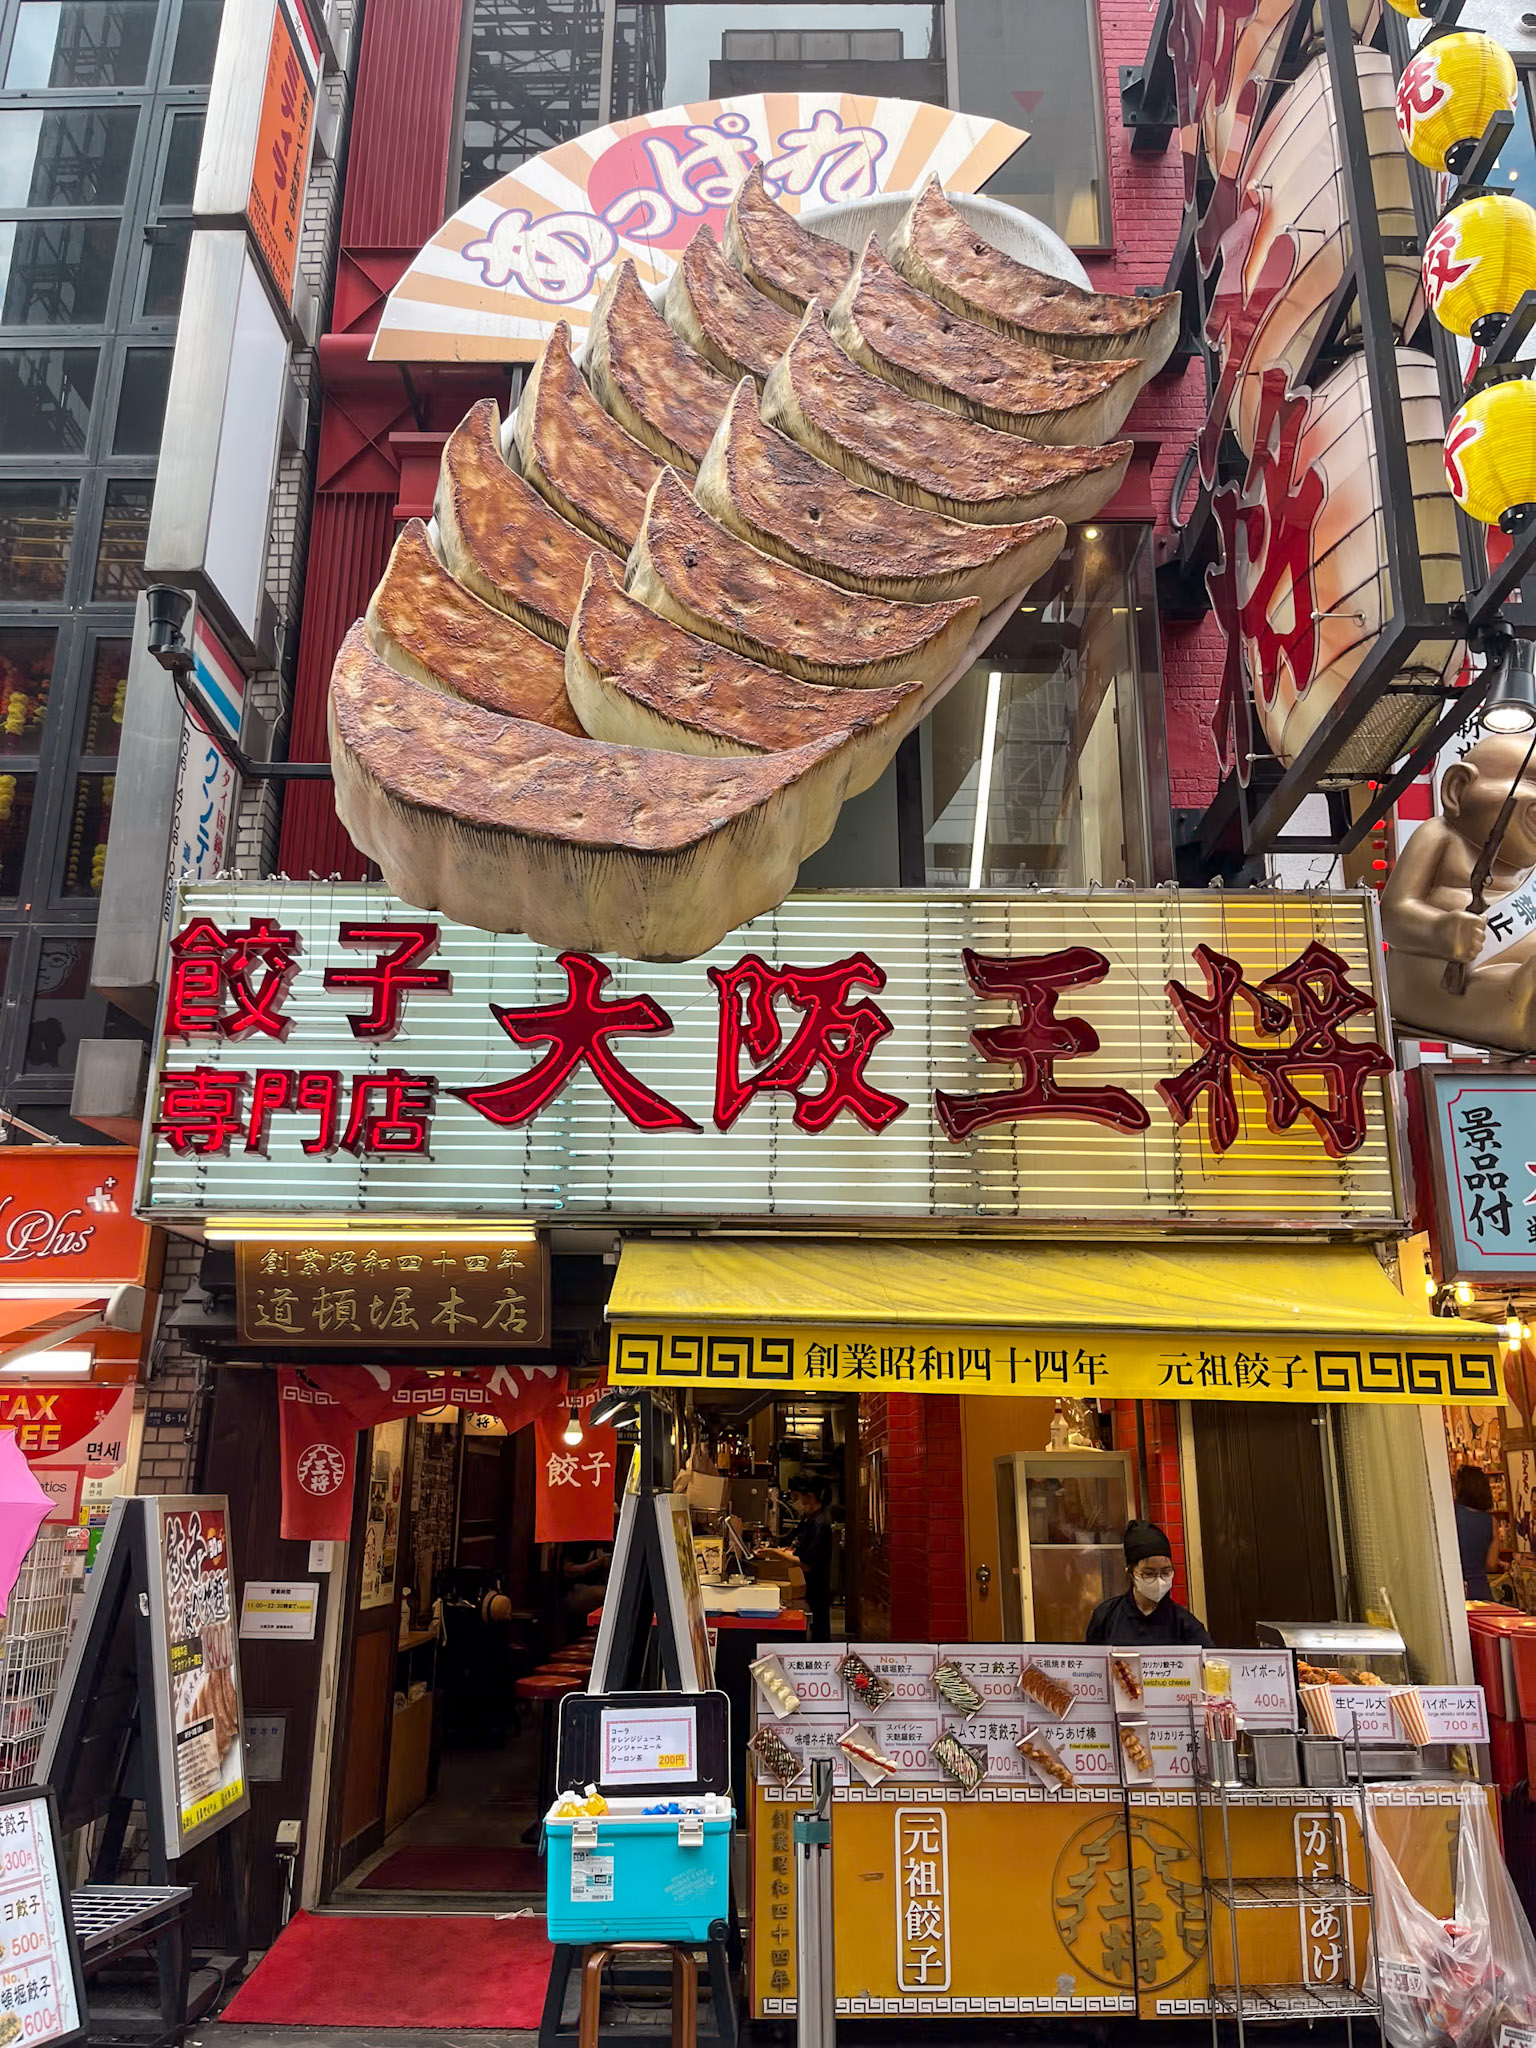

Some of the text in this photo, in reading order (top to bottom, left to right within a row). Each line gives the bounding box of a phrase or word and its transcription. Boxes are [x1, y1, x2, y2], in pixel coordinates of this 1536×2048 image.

[165, 917, 454, 1043] 餃子
[446, 940, 1395, 1158] 大阪王将
[152, 1066, 439, 1157] 専門店
[1458, 1107, 1513, 1237] 景品付
[3, 1208, 95, 1261] Plus
[259, 1248, 526, 1280] 創業昭和四十四年
[254, 1286, 532, 1335] 道頓堀本店
[803, 1342, 1309, 1389] 創業昭和四十四年 元祖餃子
[475, 1413, 490, 1429] 将
[86, 1441, 121, 1461] 면세
[310, 1458, 331, 1493] 王将
[545, 1451, 612, 1488] 餃子
[1035, 1659, 1083, 1669] 元祖焼き餃子
[1241, 1664, 1286, 1678] ハイボール
[1335, 1697, 1386, 1709] 生ビール大
[1422, 1698, 1477, 1710] ハイボール大
[610, 1735, 662, 1744] オレンジジュース
[1443, 1720, 1468, 1730] 700
[610, 1744, 662, 1752] ジンジャーエール
[610, 1754, 643, 1763] ウーロン茶
[659, 1754, 685, 1765] 200円
[0, 1894, 41, 1921] ヨ餃子
[771, 1808, 791, 1992] 創業昭和四十四年
[903, 1816, 943, 1985] 元祖餃子
[1098, 1866, 1168, 1984] 王将
[0, 1976, 51, 2013] 頓堀餃子
